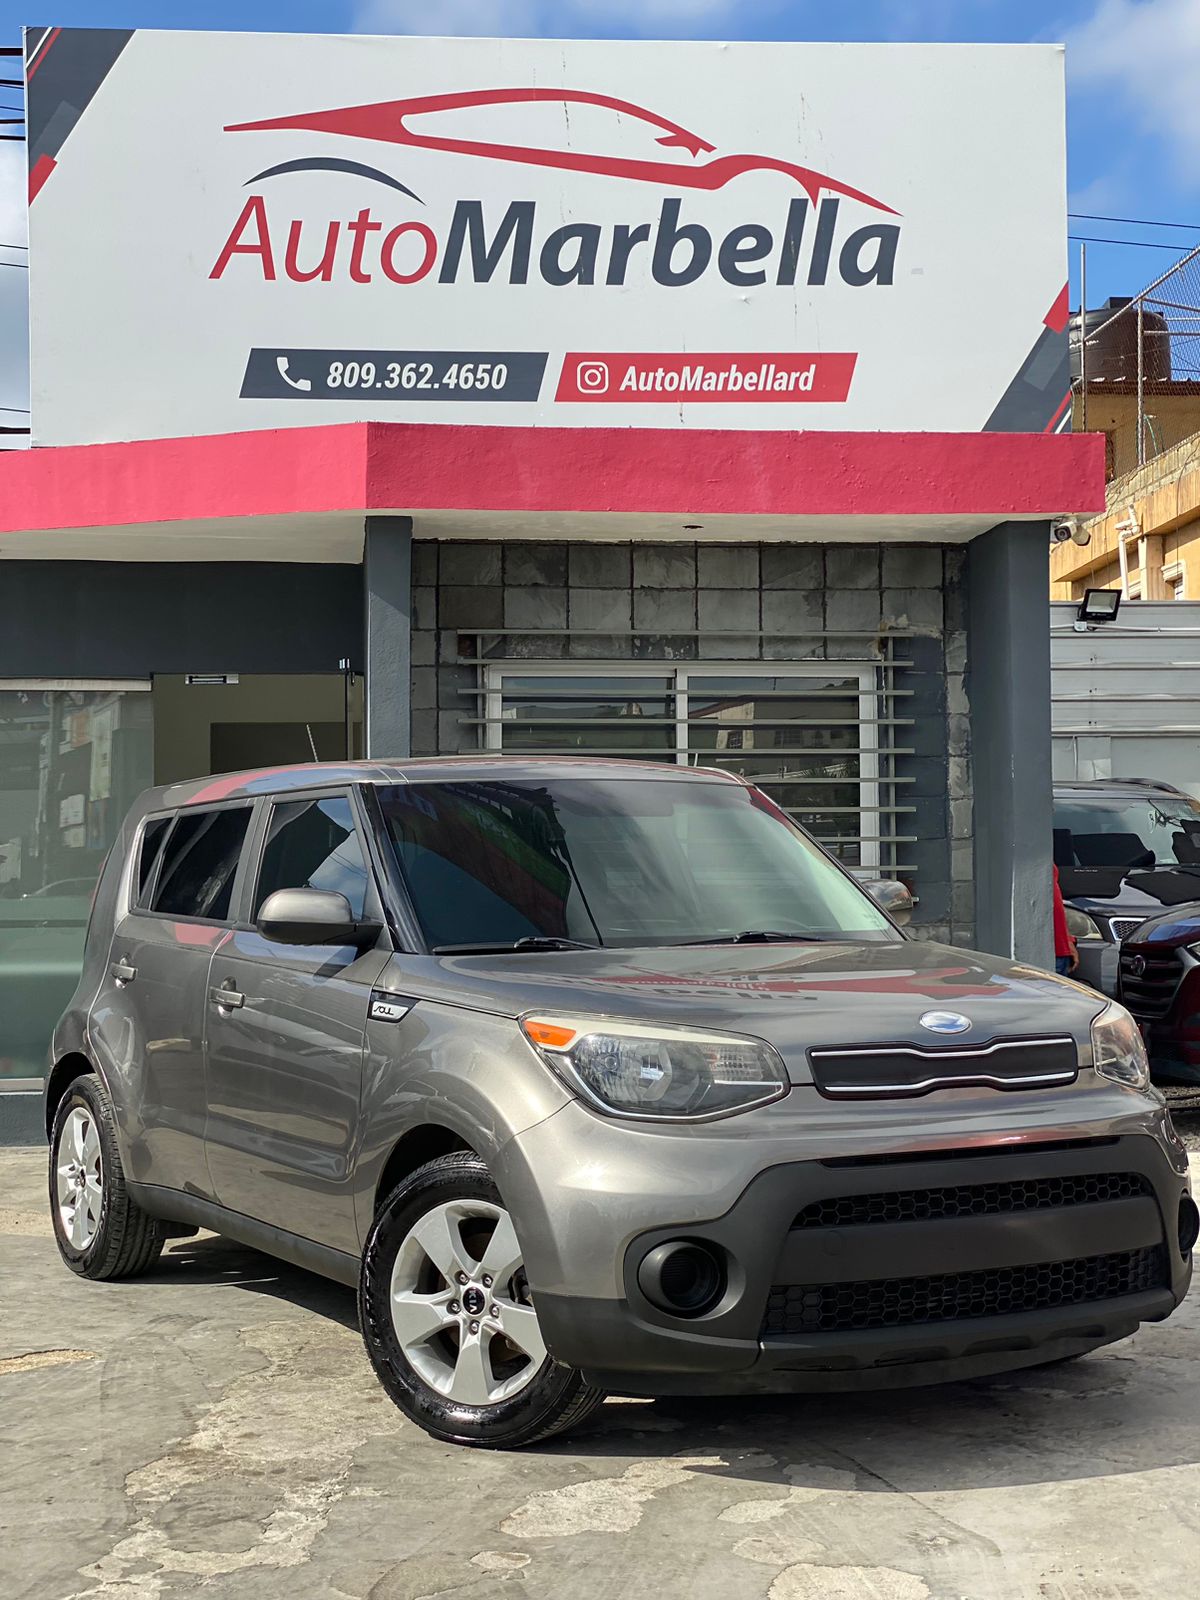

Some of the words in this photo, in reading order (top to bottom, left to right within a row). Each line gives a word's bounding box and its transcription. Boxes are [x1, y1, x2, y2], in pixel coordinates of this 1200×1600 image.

[210, 195, 900, 286] AutoMarbella
[326, 361, 508, 390] 809.362.4650
[619, 363, 817, 392] AutoMarbellard
